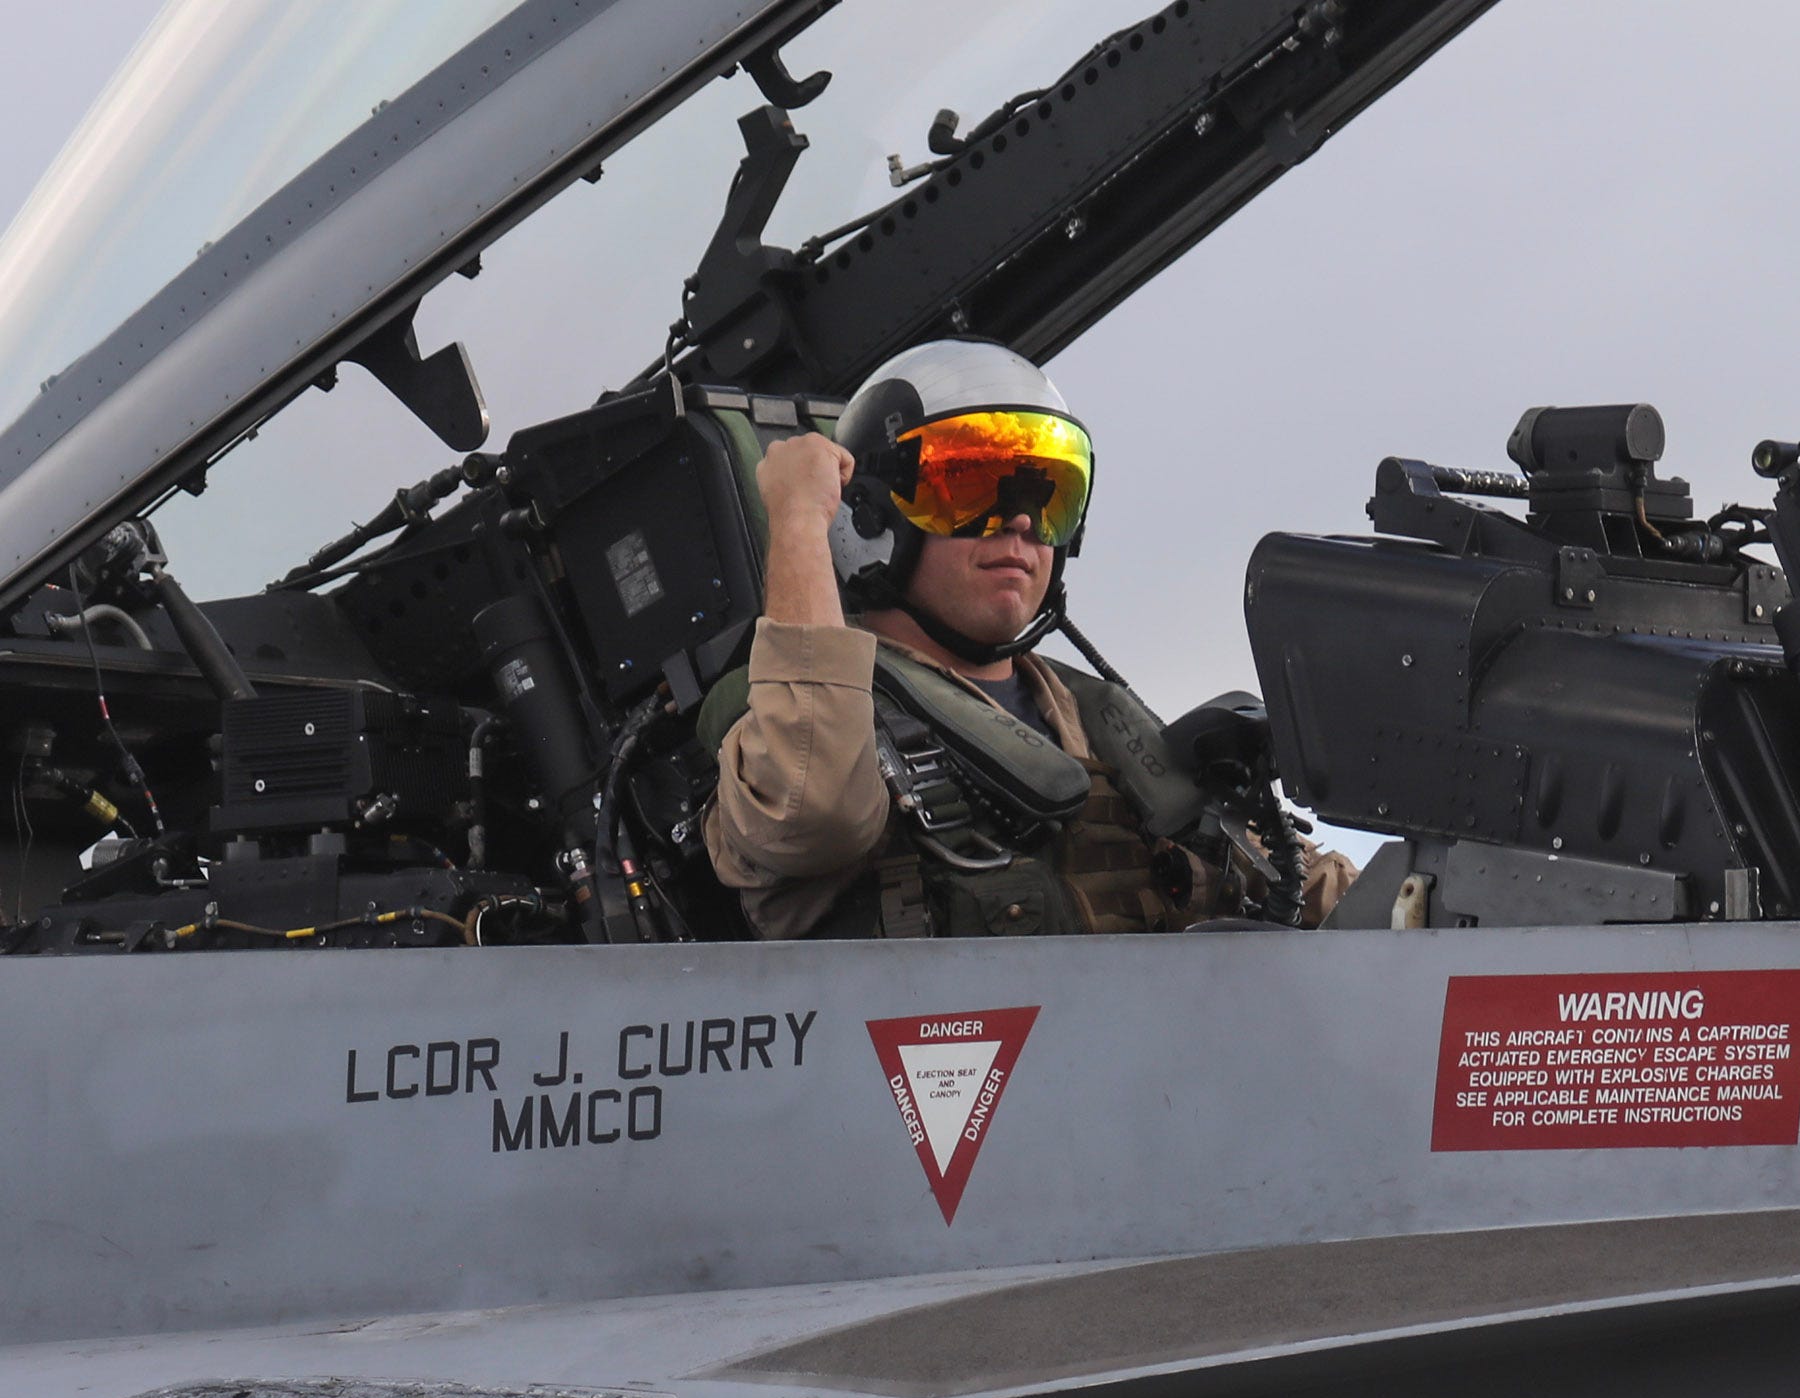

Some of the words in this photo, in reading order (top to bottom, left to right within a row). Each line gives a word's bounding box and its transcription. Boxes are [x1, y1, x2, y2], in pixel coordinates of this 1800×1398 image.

[1557, 990, 1704, 1021] WARNING
[919, 1020, 984, 1038] DANGER
[1465, 1031, 1500, 1047] THIS
[1506, 1030, 1586, 1046] AIRCRAFT
[1679, 1027, 1690, 1042] A
[1697, 1024, 1789, 1041] CARTRIDGE
[346, 1037, 501, 1103] LCDR
[533, 1031, 584, 1087] J.
[618, 1011, 818, 1080] CURRY
[1458, 1050, 1540, 1067] ACTUATED
[1547, 1048, 1647, 1065] EMERGENCY
[1653, 1046, 1717, 1062] ESCAPE
[1724, 1044, 1790, 1061] SYSTEM
[916, 1070, 954, 1079] EJECTION
[957, 1068, 978, 1077] SEAT
[938, 1080, 955, 1088] AND
[1469, 1070, 1548, 1087] EQUIPPED
[1555, 1069, 1595, 1085] WITH
[1601, 1067, 1689, 1084] EXPLOSIVE
[1695, 1064, 1774, 1081] CHARGES
[929, 1090, 962, 1099] CANOPY
[964, 1068, 1004, 1141] DANGER
[1456, 1092, 1487, 1107] SEE
[1493, 1089, 1589, 1106] APPLICABLE
[1595, 1086, 1710, 1104] MAINTENANCE
[1717, 1085, 1783, 1101] MANUAL
[492, 1086, 663, 1153] MMCO
[890, 1074, 925, 1146] DANGER
[1493, 1111, 1525, 1126] FOR
[1532, 1109, 1618, 1125] COMPLETE
[1624, 1105, 1742, 1123] INSTRUCTIONS
